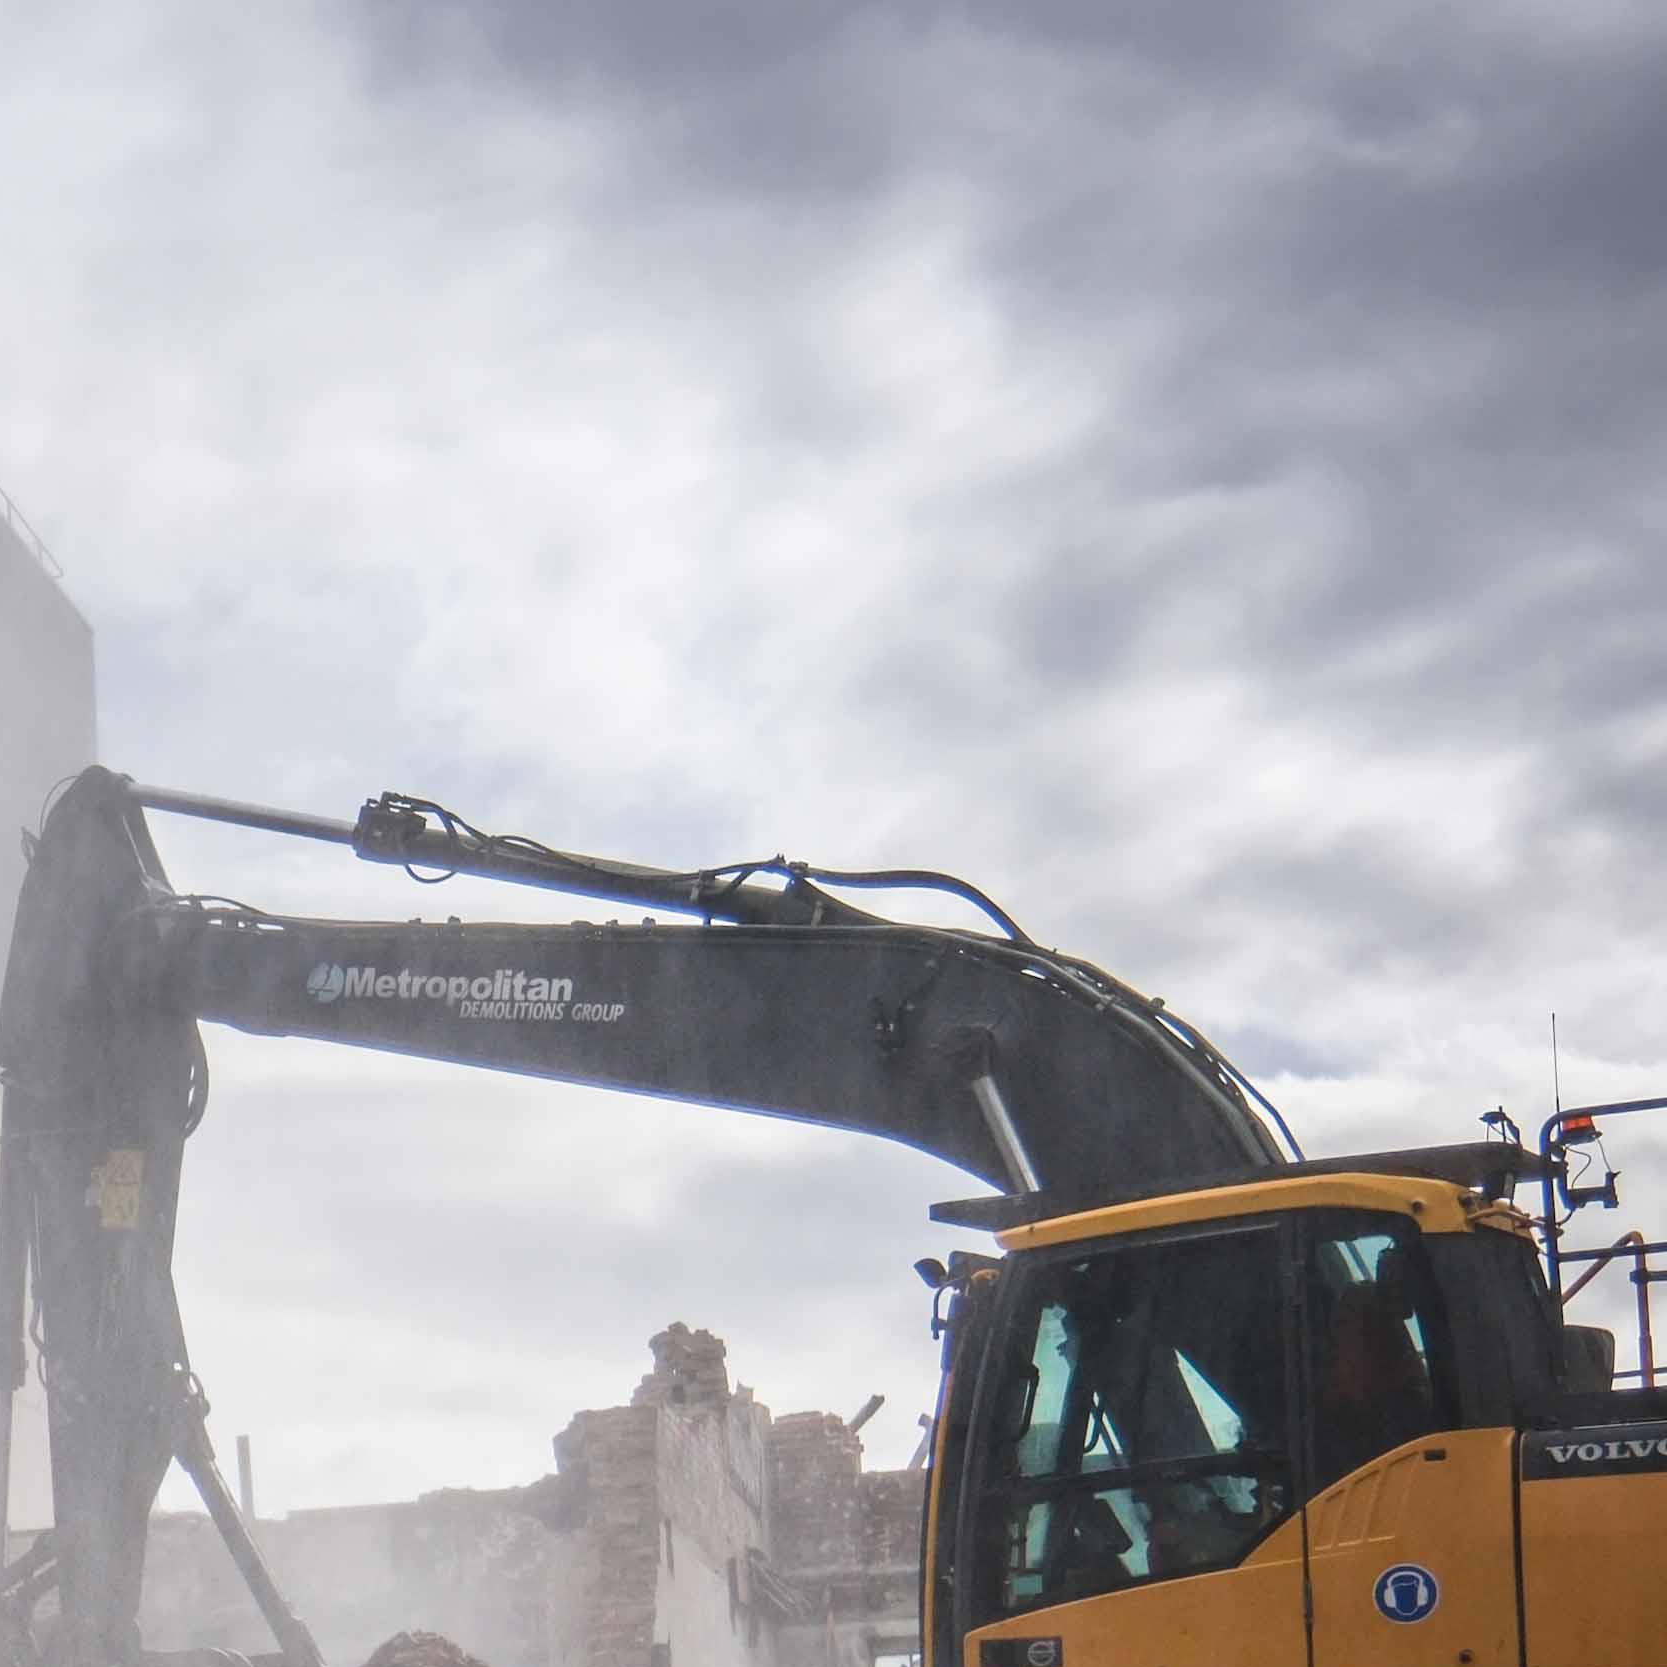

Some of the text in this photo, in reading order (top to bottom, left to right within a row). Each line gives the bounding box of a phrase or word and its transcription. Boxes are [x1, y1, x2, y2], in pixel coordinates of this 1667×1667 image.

[345, 966, 573, 1006] Metropolitan
[460, 1001, 625, 1022] DEMOLITIONS GROUP
